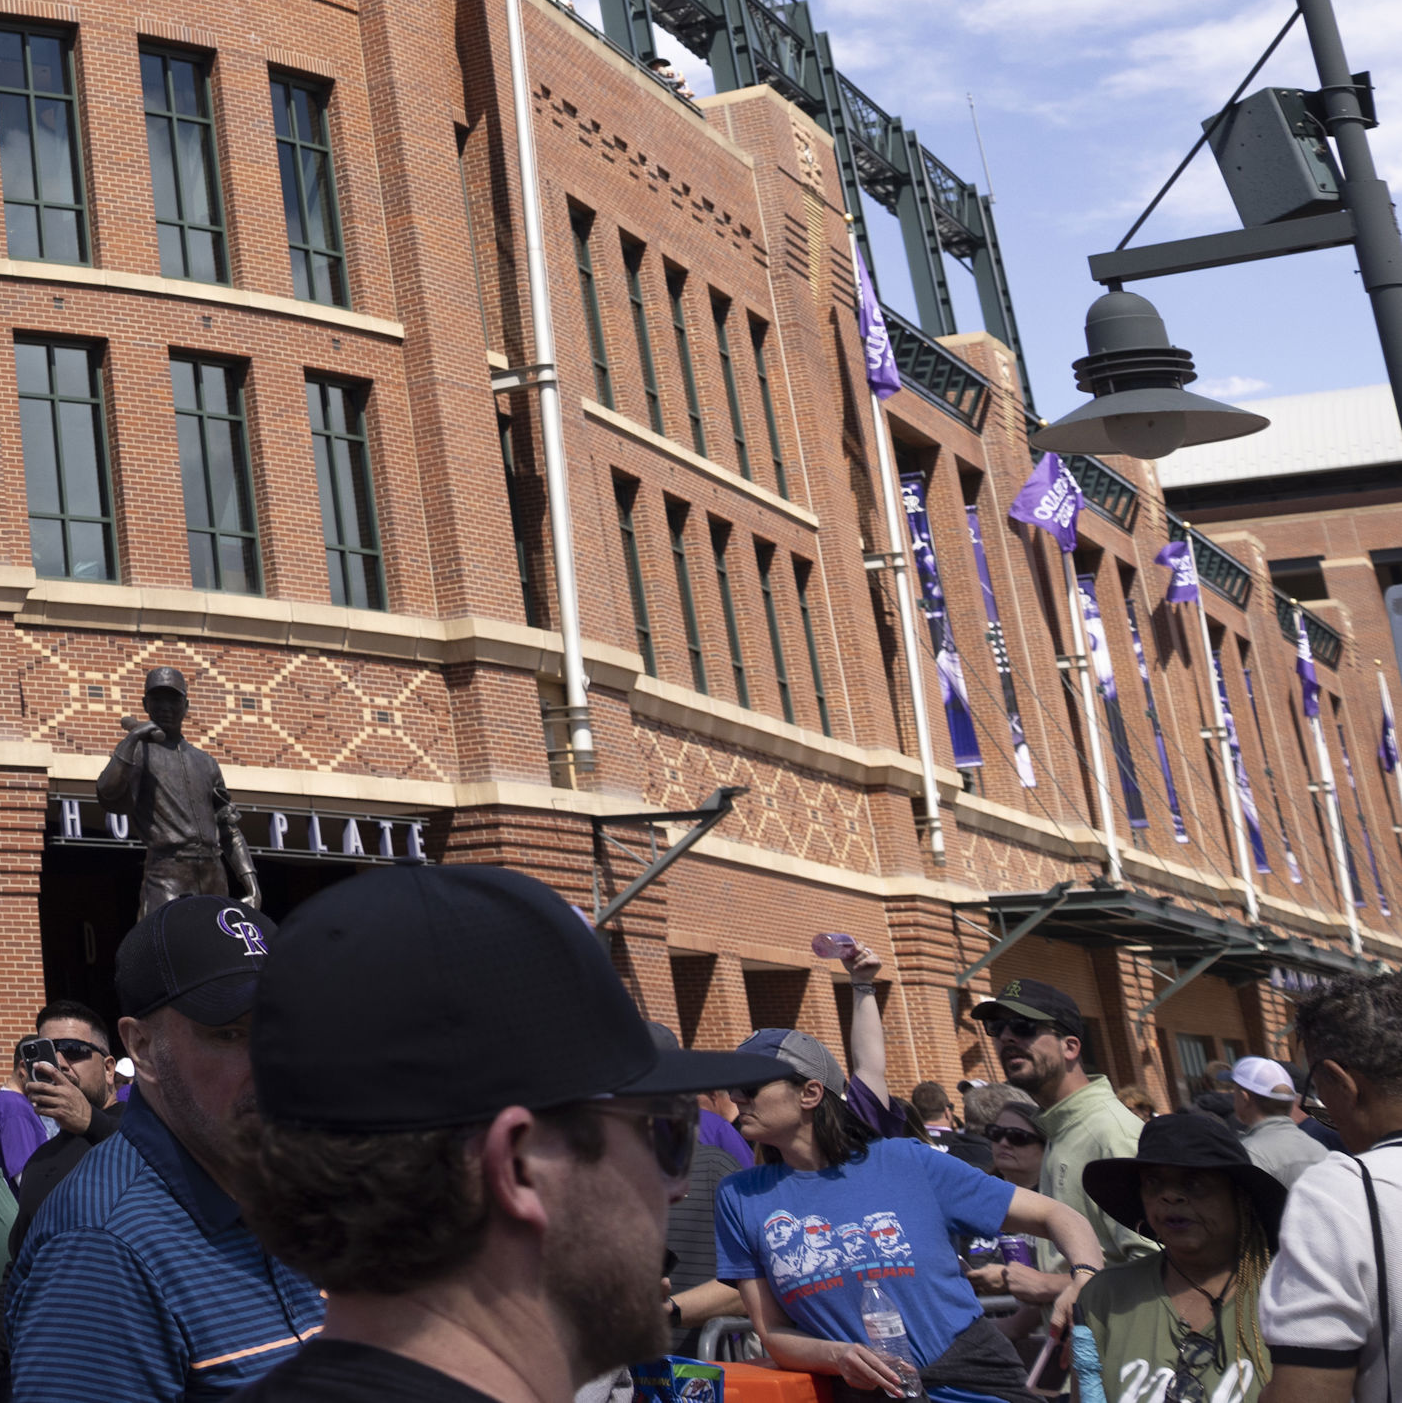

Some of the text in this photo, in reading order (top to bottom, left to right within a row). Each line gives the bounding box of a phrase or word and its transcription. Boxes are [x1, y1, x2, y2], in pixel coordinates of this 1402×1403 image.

[269, 812, 427, 860] PLATE
[216, 907, 269, 956] CR
[851, 1260, 915, 1282] TEAM
